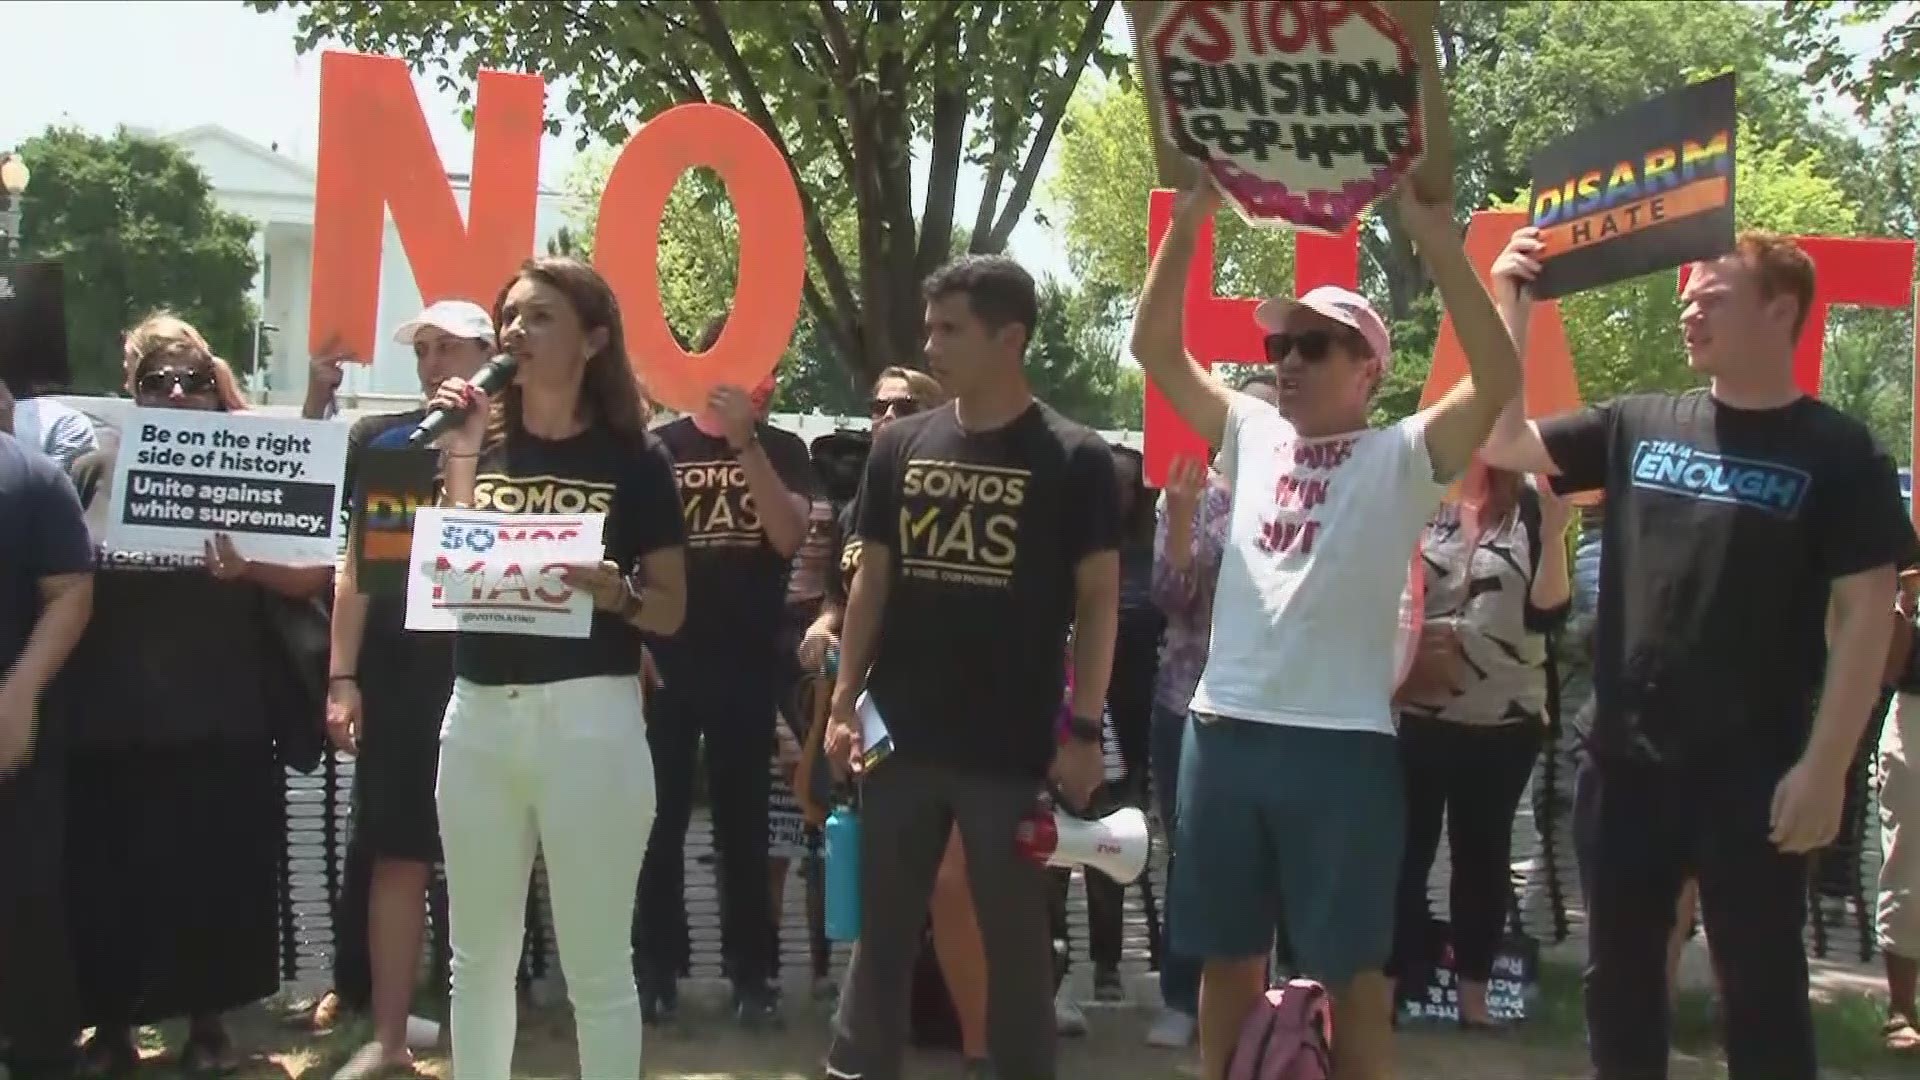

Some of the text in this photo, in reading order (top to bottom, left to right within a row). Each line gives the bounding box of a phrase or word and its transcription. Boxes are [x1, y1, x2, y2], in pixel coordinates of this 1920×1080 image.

[1180, 0, 1352, 63] STOP
[1165, 57, 1418, 117] GUN SHOW
[1533, 128, 1730, 227] DISARM
[308, 50, 806, 416] NO
[1571, 198, 1665, 245] HATE
[141, 424, 311, 455] Be on the right
[1650, 440, 1693, 459] TEAM
[137, 448, 306, 479] side of history.
[1635, 453, 1798, 508] ENOUGH
[133, 476, 283, 505] Unite against
[474, 482, 614, 515] SOMOS
[903, 468, 1026, 506] SOMOS
[131, 500, 326, 531] white supremacy.
[899, 503, 1018, 565] MÁS
